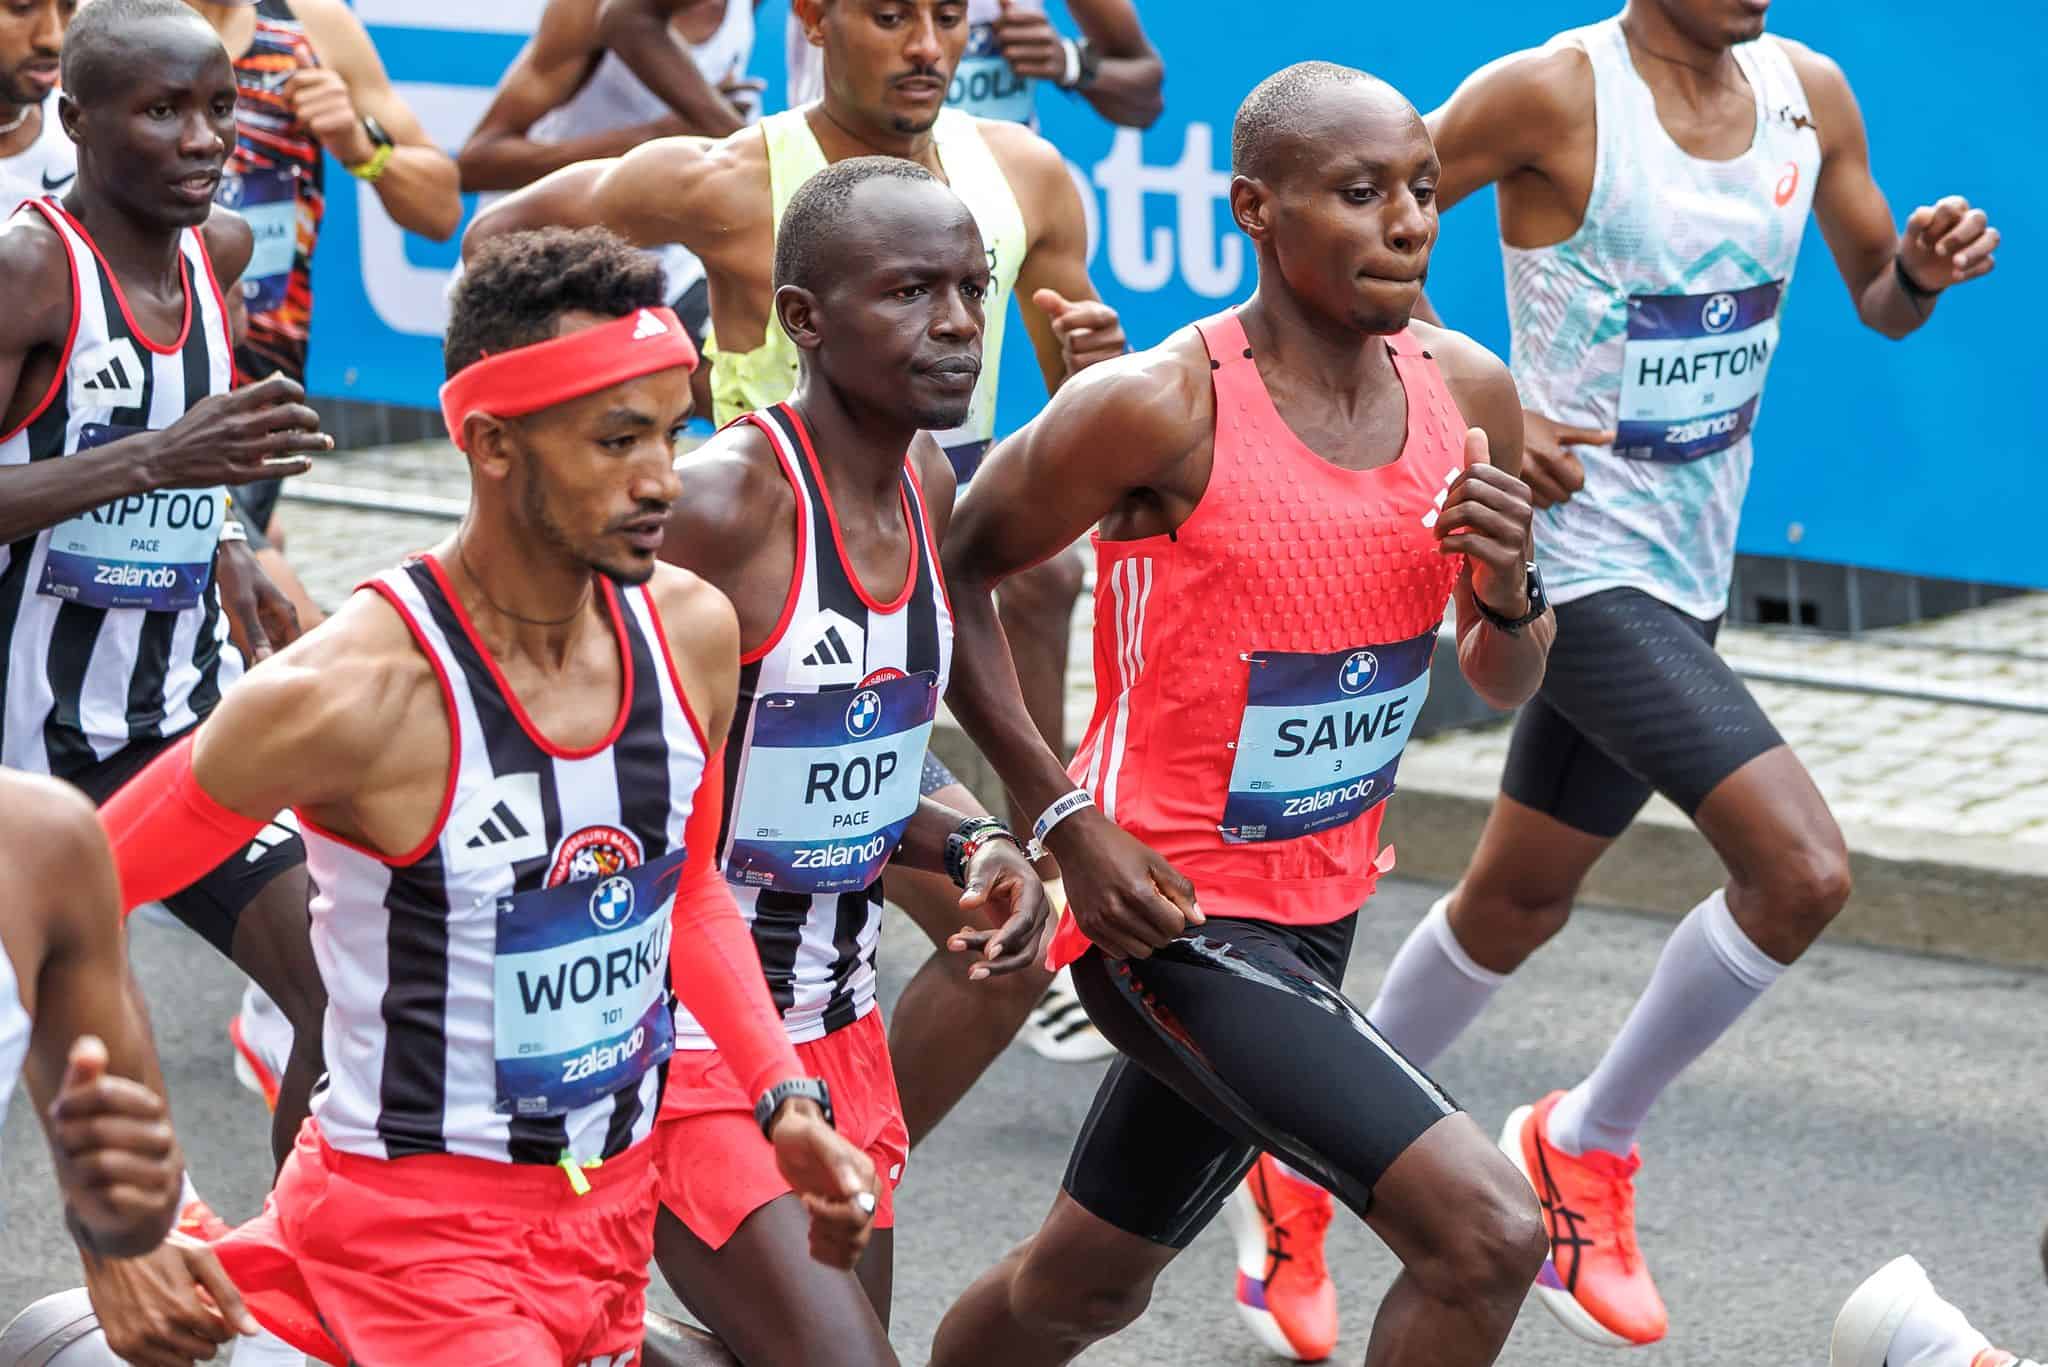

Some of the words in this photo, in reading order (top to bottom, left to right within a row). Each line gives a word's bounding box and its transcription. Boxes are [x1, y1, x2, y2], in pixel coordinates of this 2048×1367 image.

[1063, 122, 1244, 298] tt
[130, 538, 160, 552] PACE
[94, 564, 177, 589] zalando
[1273, 696, 1409, 758] SAWE
[804, 751, 898, 804] ROP
[1334, 760, 1343, 772] 3
[1282, 779, 1375, 817] zalando
[832, 810, 870, 828] PACE
[791, 836, 885, 869] zalando
[602, 1008, 623, 1025] 101
[561, 1026, 645, 1083] zalando
